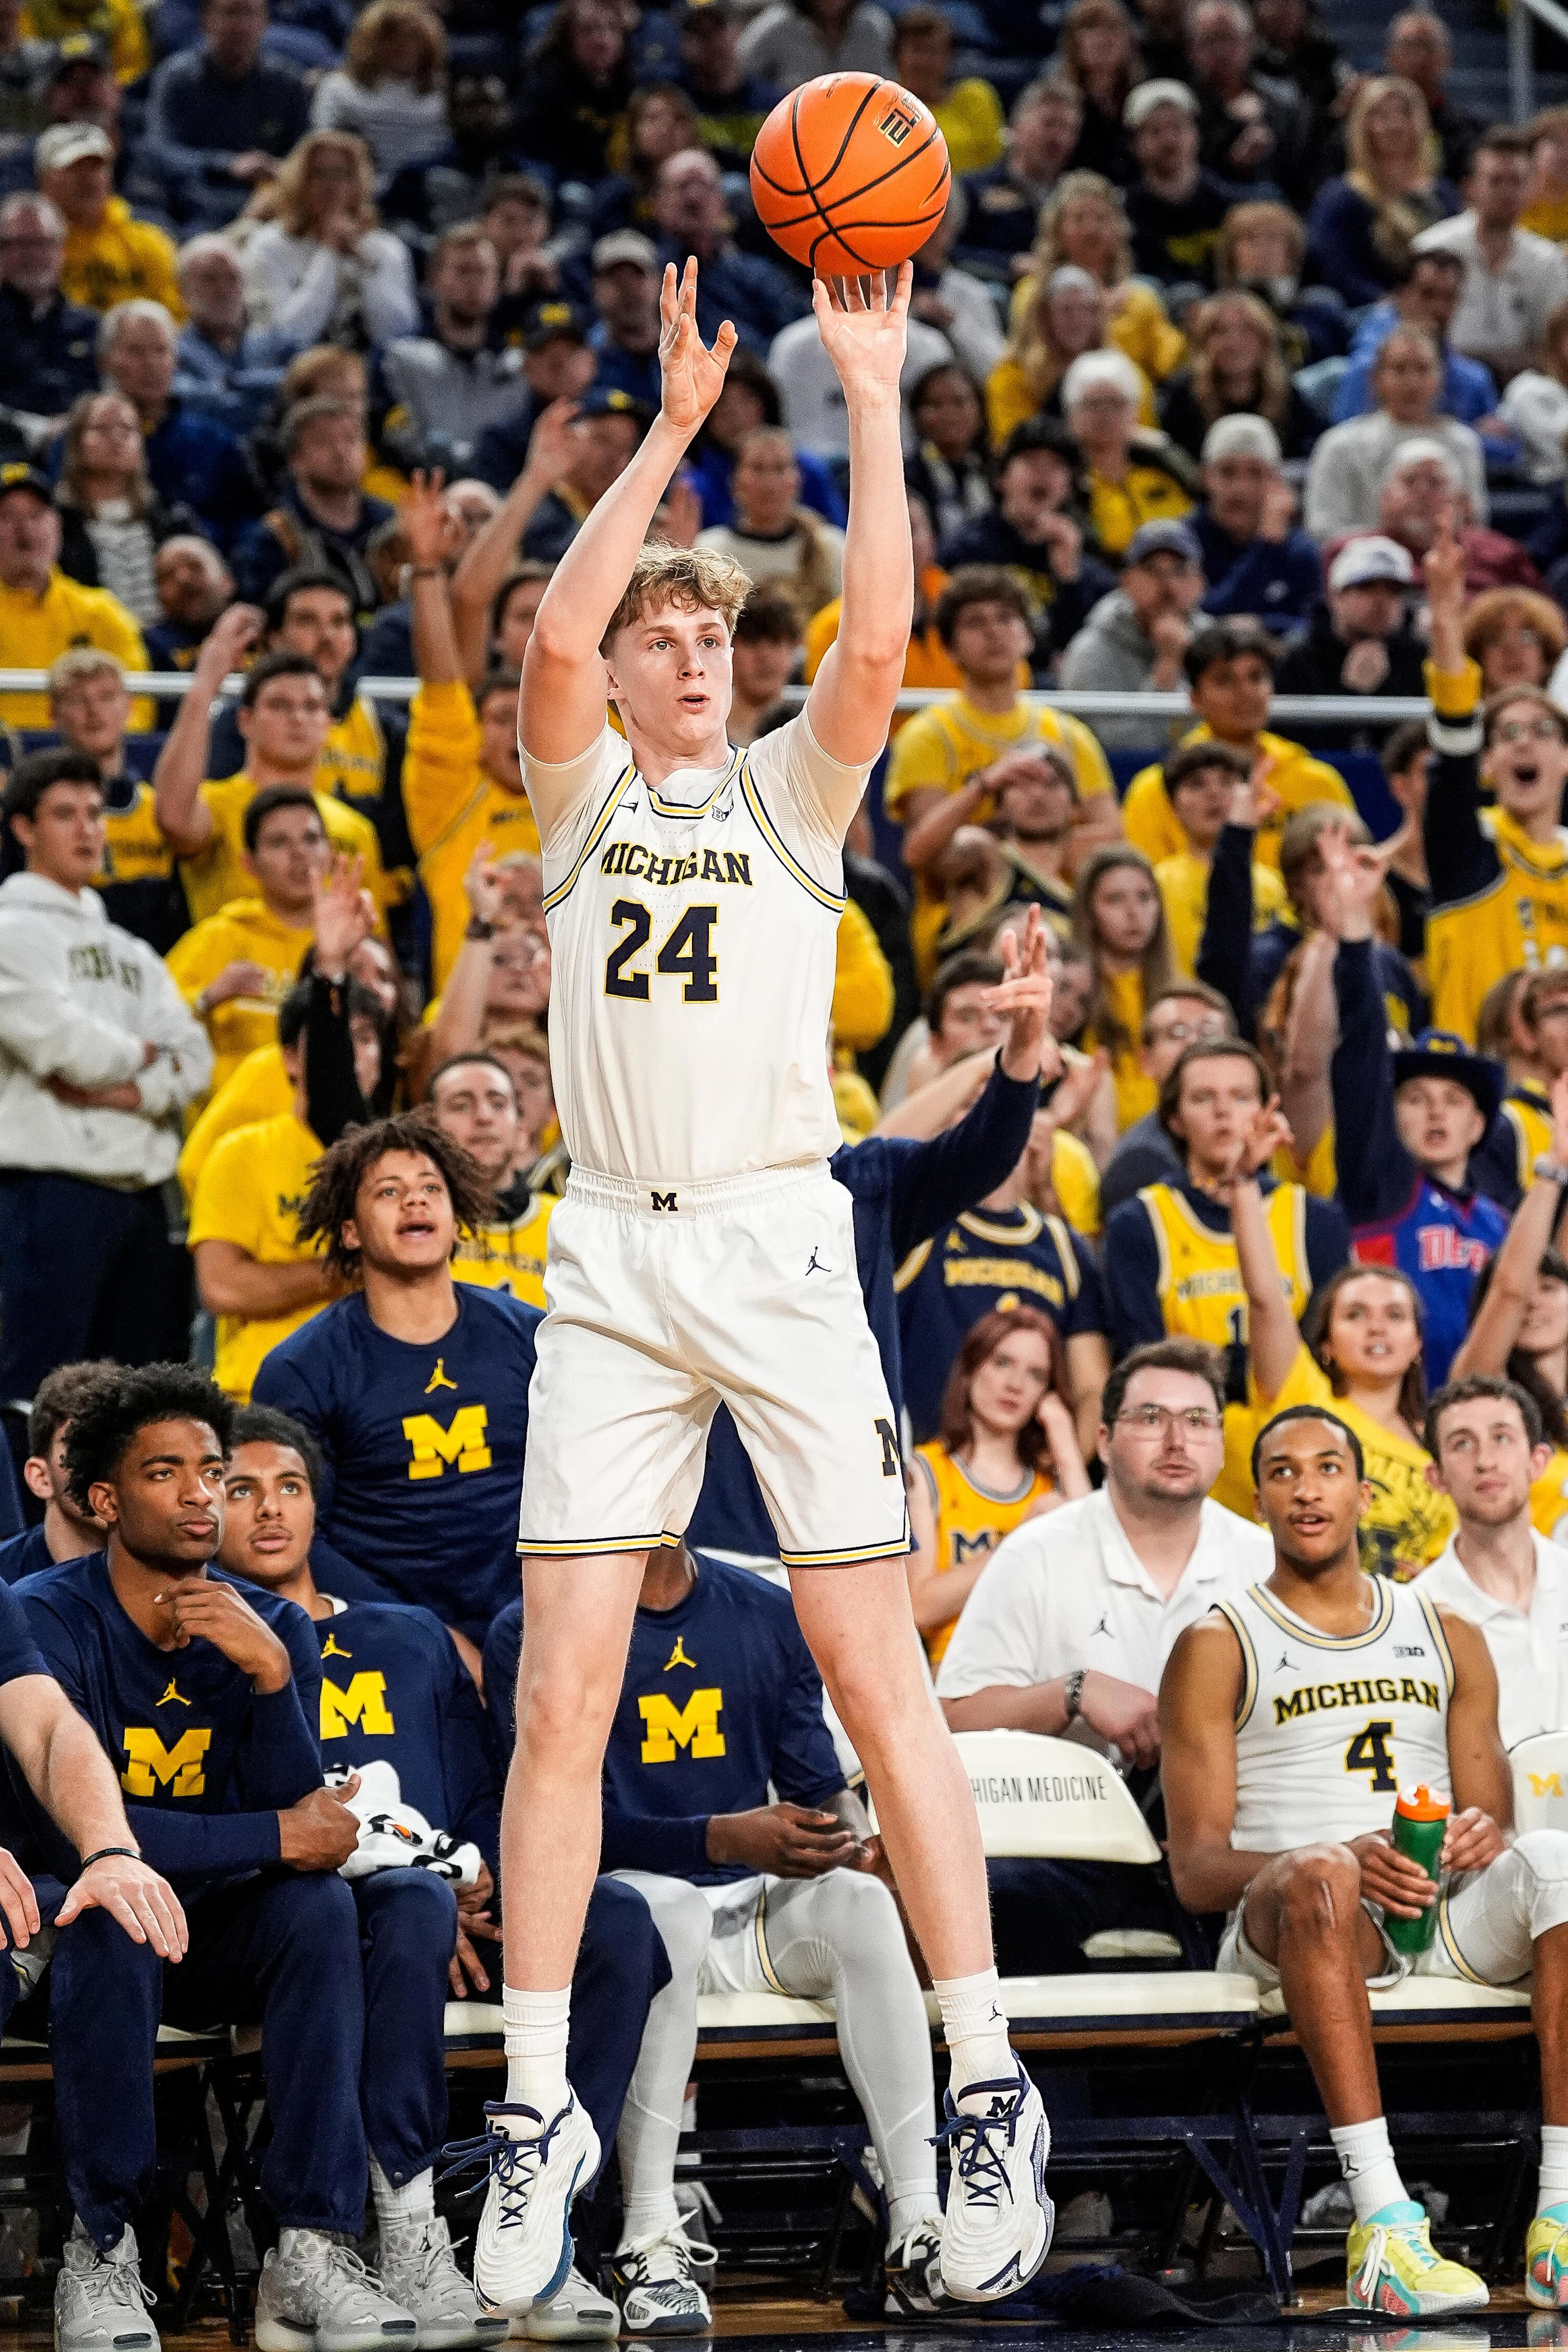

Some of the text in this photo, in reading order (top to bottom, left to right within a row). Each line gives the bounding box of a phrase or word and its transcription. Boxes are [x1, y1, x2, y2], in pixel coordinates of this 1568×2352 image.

[601, 841, 754, 887] MICHIGAN
[604, 897, 719, 1004] 24
[650, 1191, 679, 1212] M
[402, 1404, 492, 1480] M
[320, 1670, 395, 1740] M
[638, 1687, 726, 1764] M
[1272, 1677, 1441, 1726] MICHIGAN
[121, 1726, 212, 1797] M
[1345, 1718, 1398, 1792] 4
[1027, 1776, 1107, 1803] MEDICINE
[1527, 1773, 1564, 1797] M
[986, 2095, 1017, 2118] M
